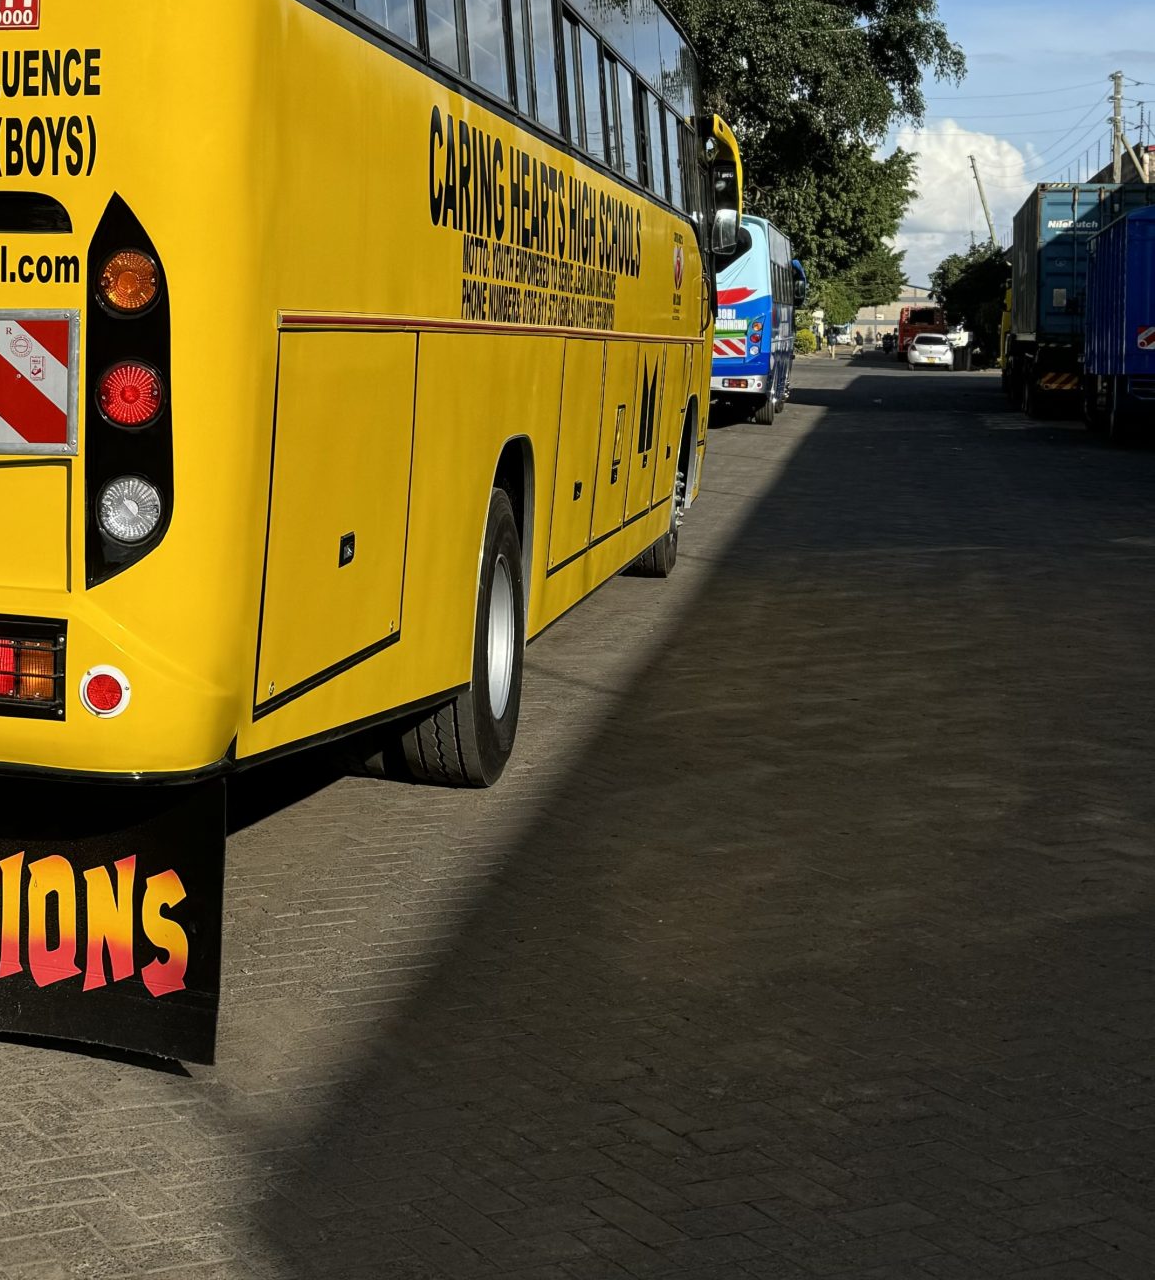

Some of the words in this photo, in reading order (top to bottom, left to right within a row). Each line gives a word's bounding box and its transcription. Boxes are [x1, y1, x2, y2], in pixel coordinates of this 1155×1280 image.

[429, 105, 505, 241] CARING
[509, 146, 566, 260] HEARTS
[569, 175, 596, 267] HIGH
[598, 190, 641, 280] SCHOOLS
[460, 278, 488, 321] PHONE
